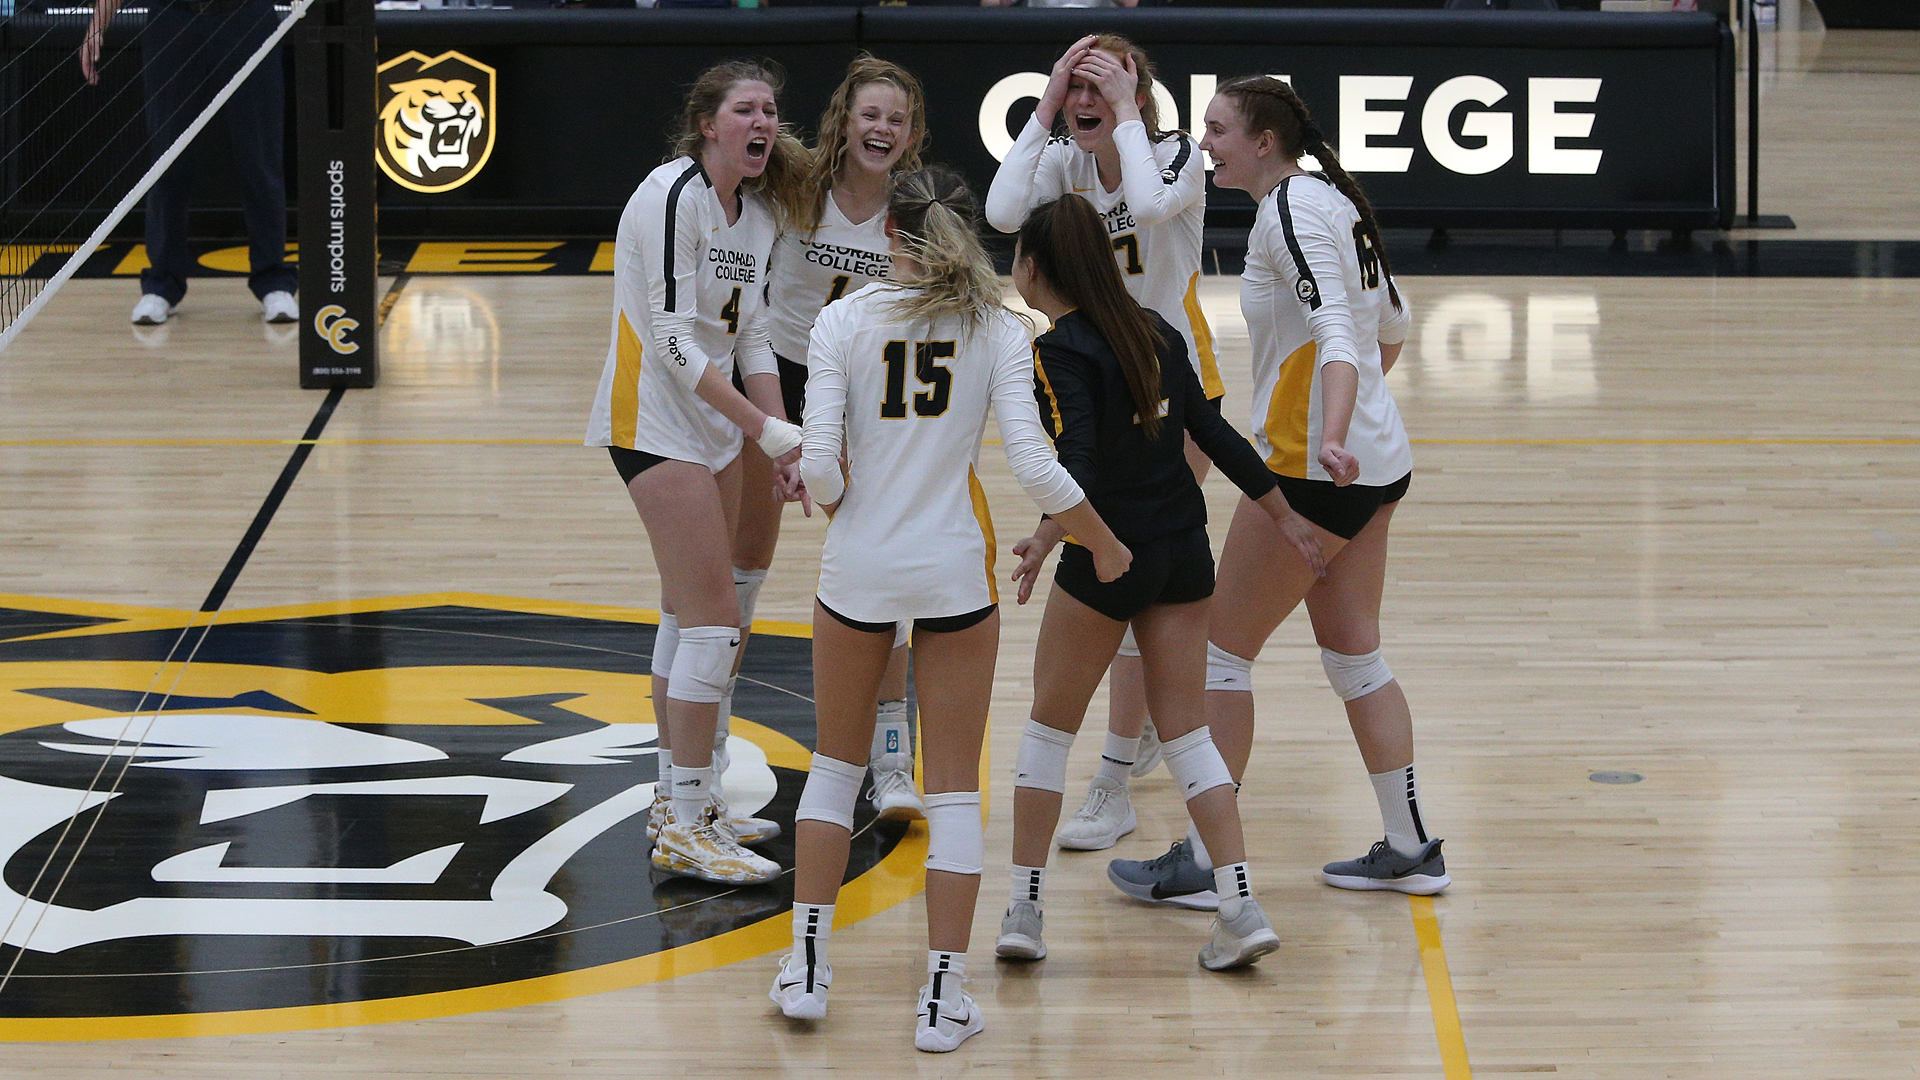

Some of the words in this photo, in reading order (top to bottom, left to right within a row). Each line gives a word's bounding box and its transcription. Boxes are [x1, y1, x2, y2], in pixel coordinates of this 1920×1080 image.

[327, 160, 347, 219] sports
[327, 220, 347, 293] imports
[715, 265, 756, 284] COLLEGE
[805, 250, 890, 278] COLLEGE
[1111, 232, 1145, 276] 7
[719, 286, 742, 335] 4
[879, 339, 957, 420] 15
